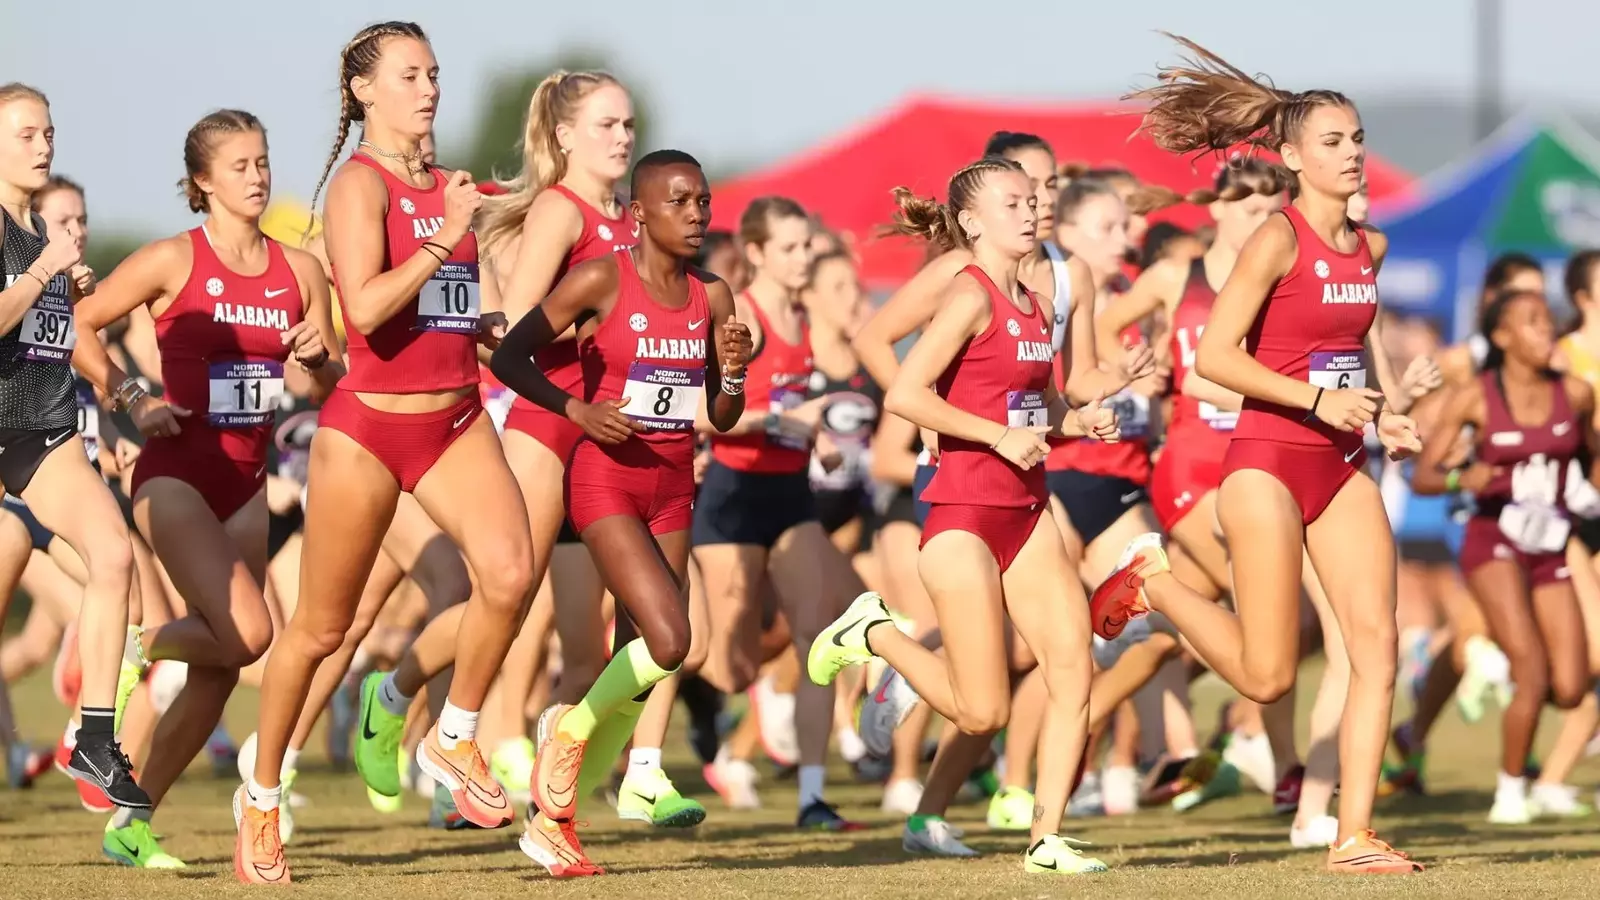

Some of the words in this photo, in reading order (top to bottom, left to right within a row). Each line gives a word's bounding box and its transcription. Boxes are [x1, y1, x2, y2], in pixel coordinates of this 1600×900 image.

[440, 265, 467, 273] NORTH
[435, 271, 472, 280] ALABAMA
[41, 295, 65, 305] NORTH
[441, 282, 469, 314] 10
[37, 301, 69, 312] ALABAMA
[213, 302, 289, 331] ALABAMA
[34, 311, 71, 345] 397
[436, 320, 471, 329] SHOWCASE
[635, 337, 706, 359] ALABAMA
[36, 348, 64, 360] SHOWCASE
[226, 370, 271, 378] ALABAMA
[654, 370, 687, 378] NORTH
[645, 375, 691, 385] ALABAMA
[233, 380, 261, 410] 11
[653, 386, 673, 416] 8
[228, 416, 264, 424] SHOWCASE
